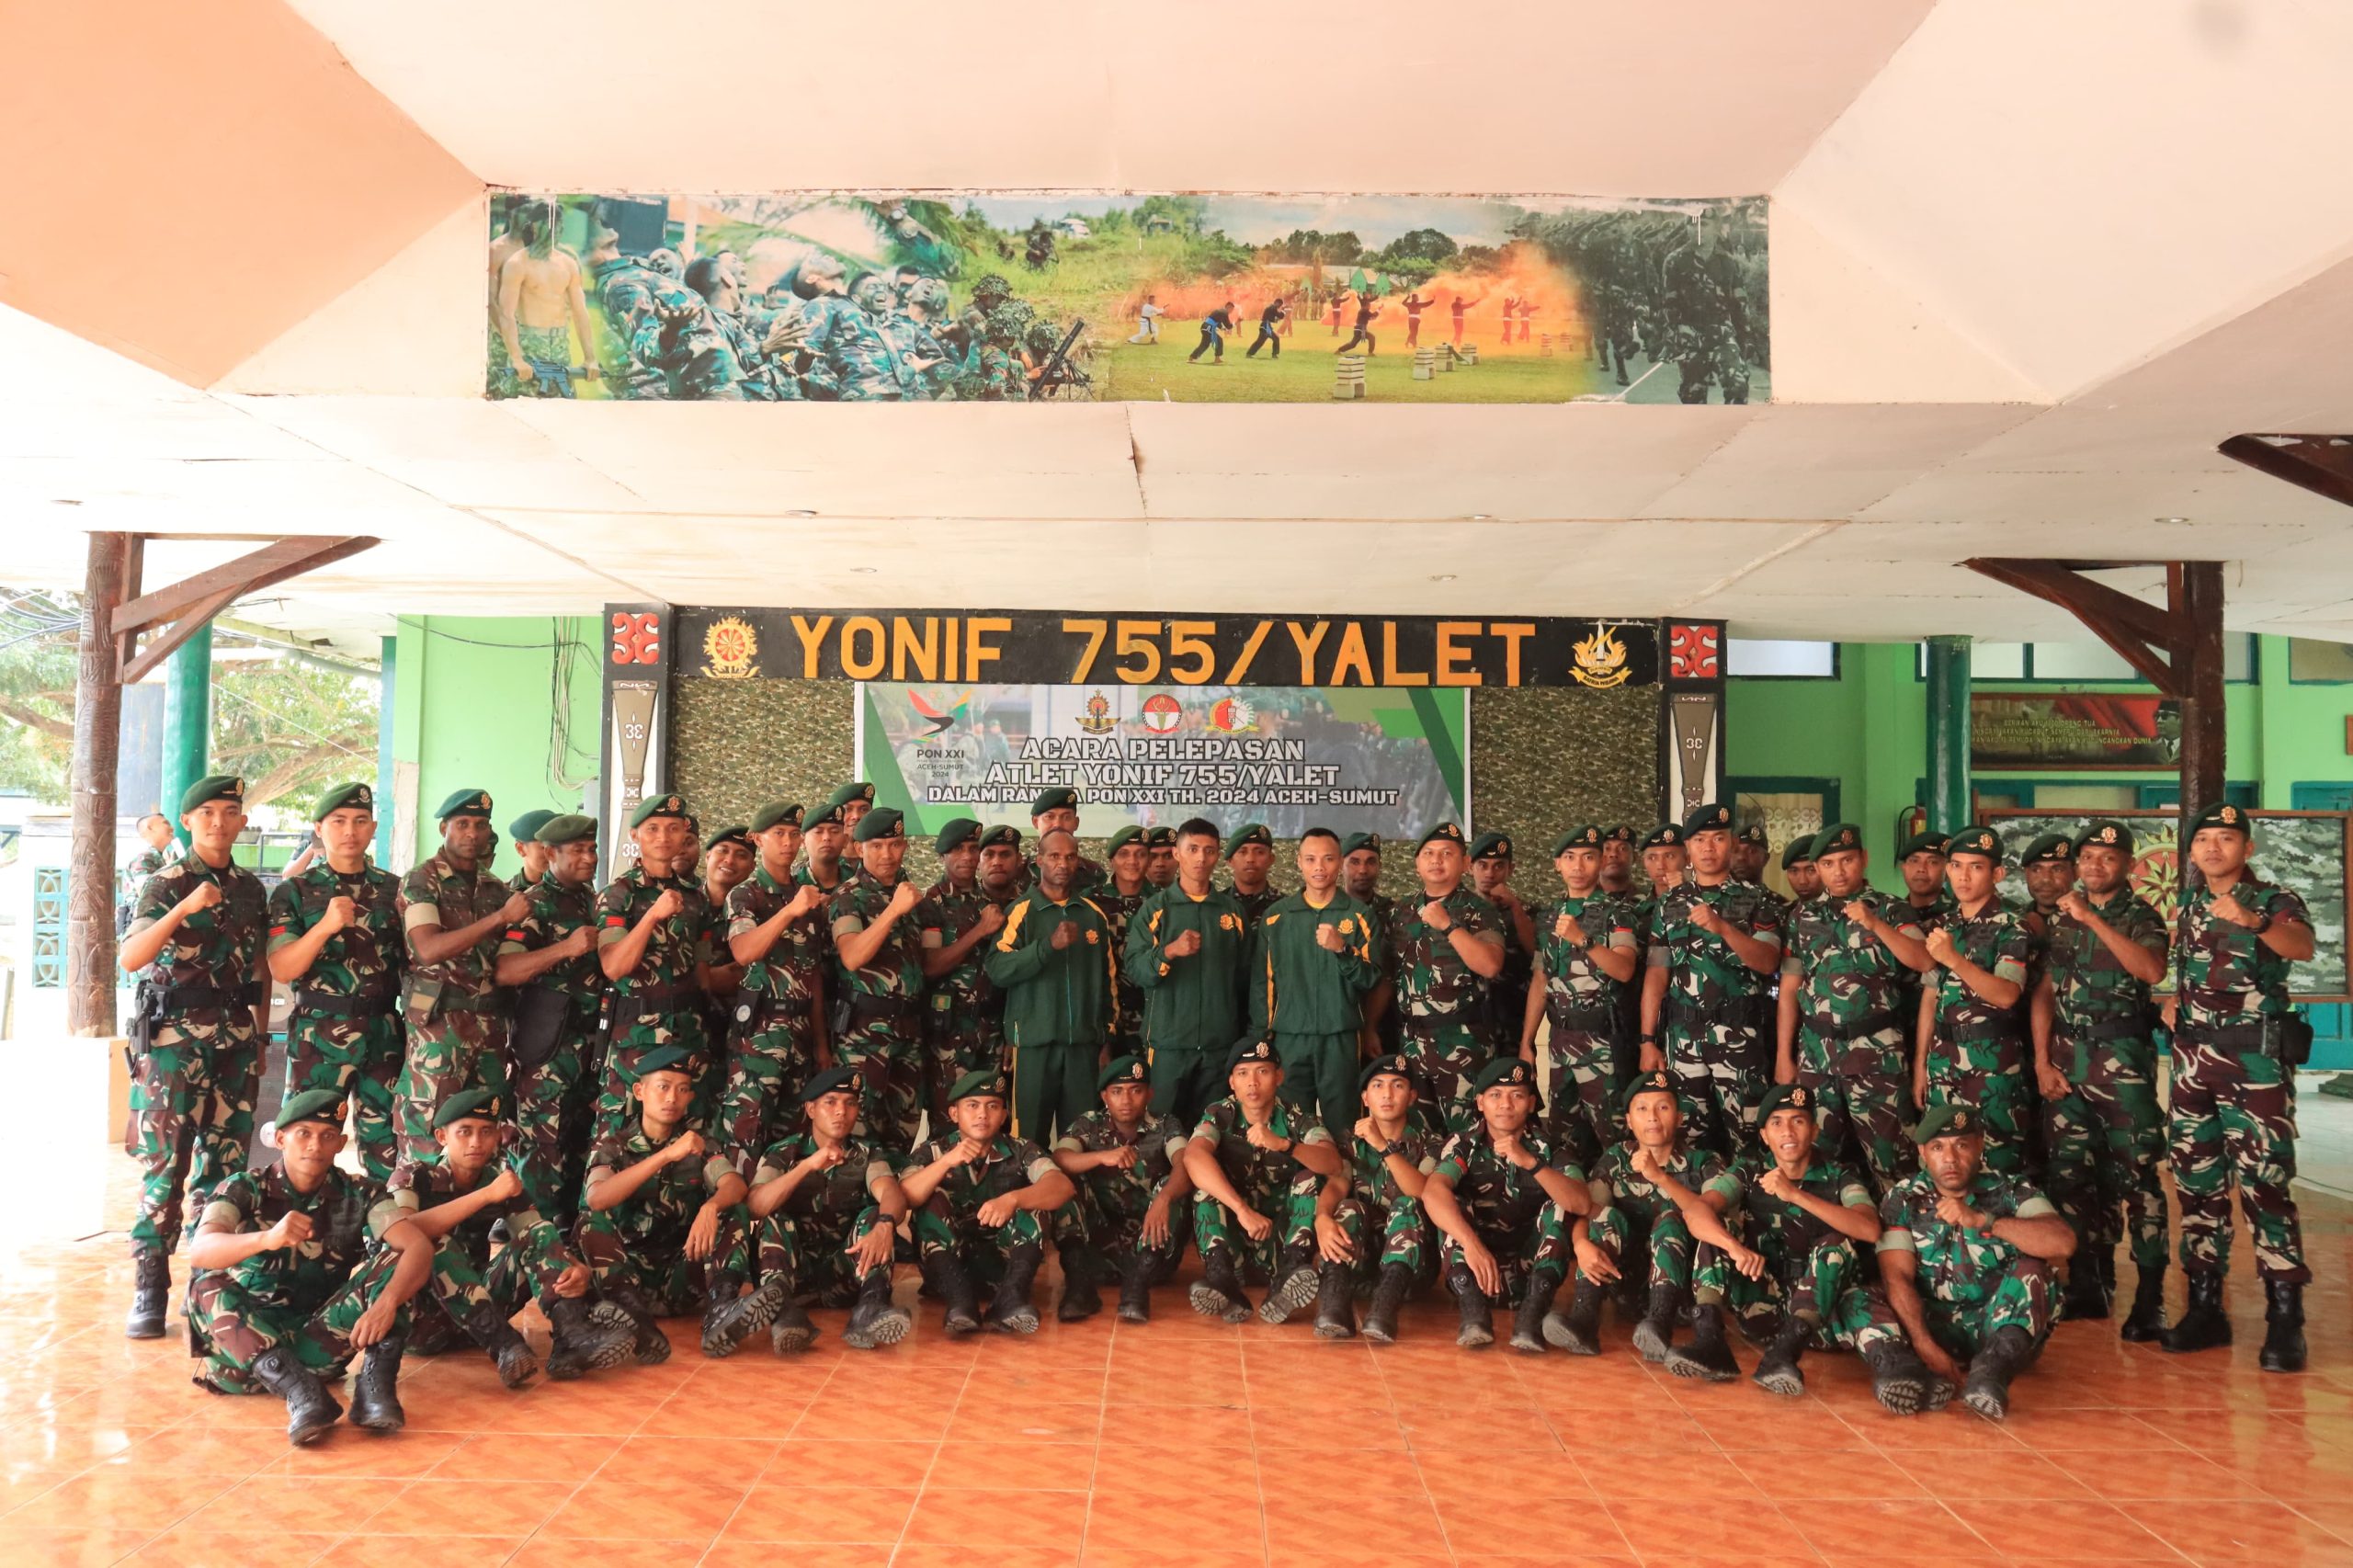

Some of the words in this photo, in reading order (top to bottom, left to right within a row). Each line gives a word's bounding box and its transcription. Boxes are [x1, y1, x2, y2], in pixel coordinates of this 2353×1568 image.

[790, 616, 1012, 681] YONIF
[1062, 619, 1536, 685] 755/YALET
[916, 749, 942, 758] PON
[945, 749, 964, 758] XXI
[1019, 737, 1123, 761] ACARA
[1128, 738, 1305, 761] PELEPASAN
[985, 762, 1077, 786] ATLET
[1082, 763, 1174, 787] YONIF
[1178, 764, 1340, 788] 755/YALET
[926, 785, 997, 803] DALAM
[1001, 786, 1083, 804] RANA
[1086, 788, 1129, 804] PON
[1129, 788, 1165, 805] XXI
[1168, 788, 1201, 805] TH.
[1205, 789, 1260, 805] 2024
[1262, 788, 1400, 806] ACEH-SUMUT
